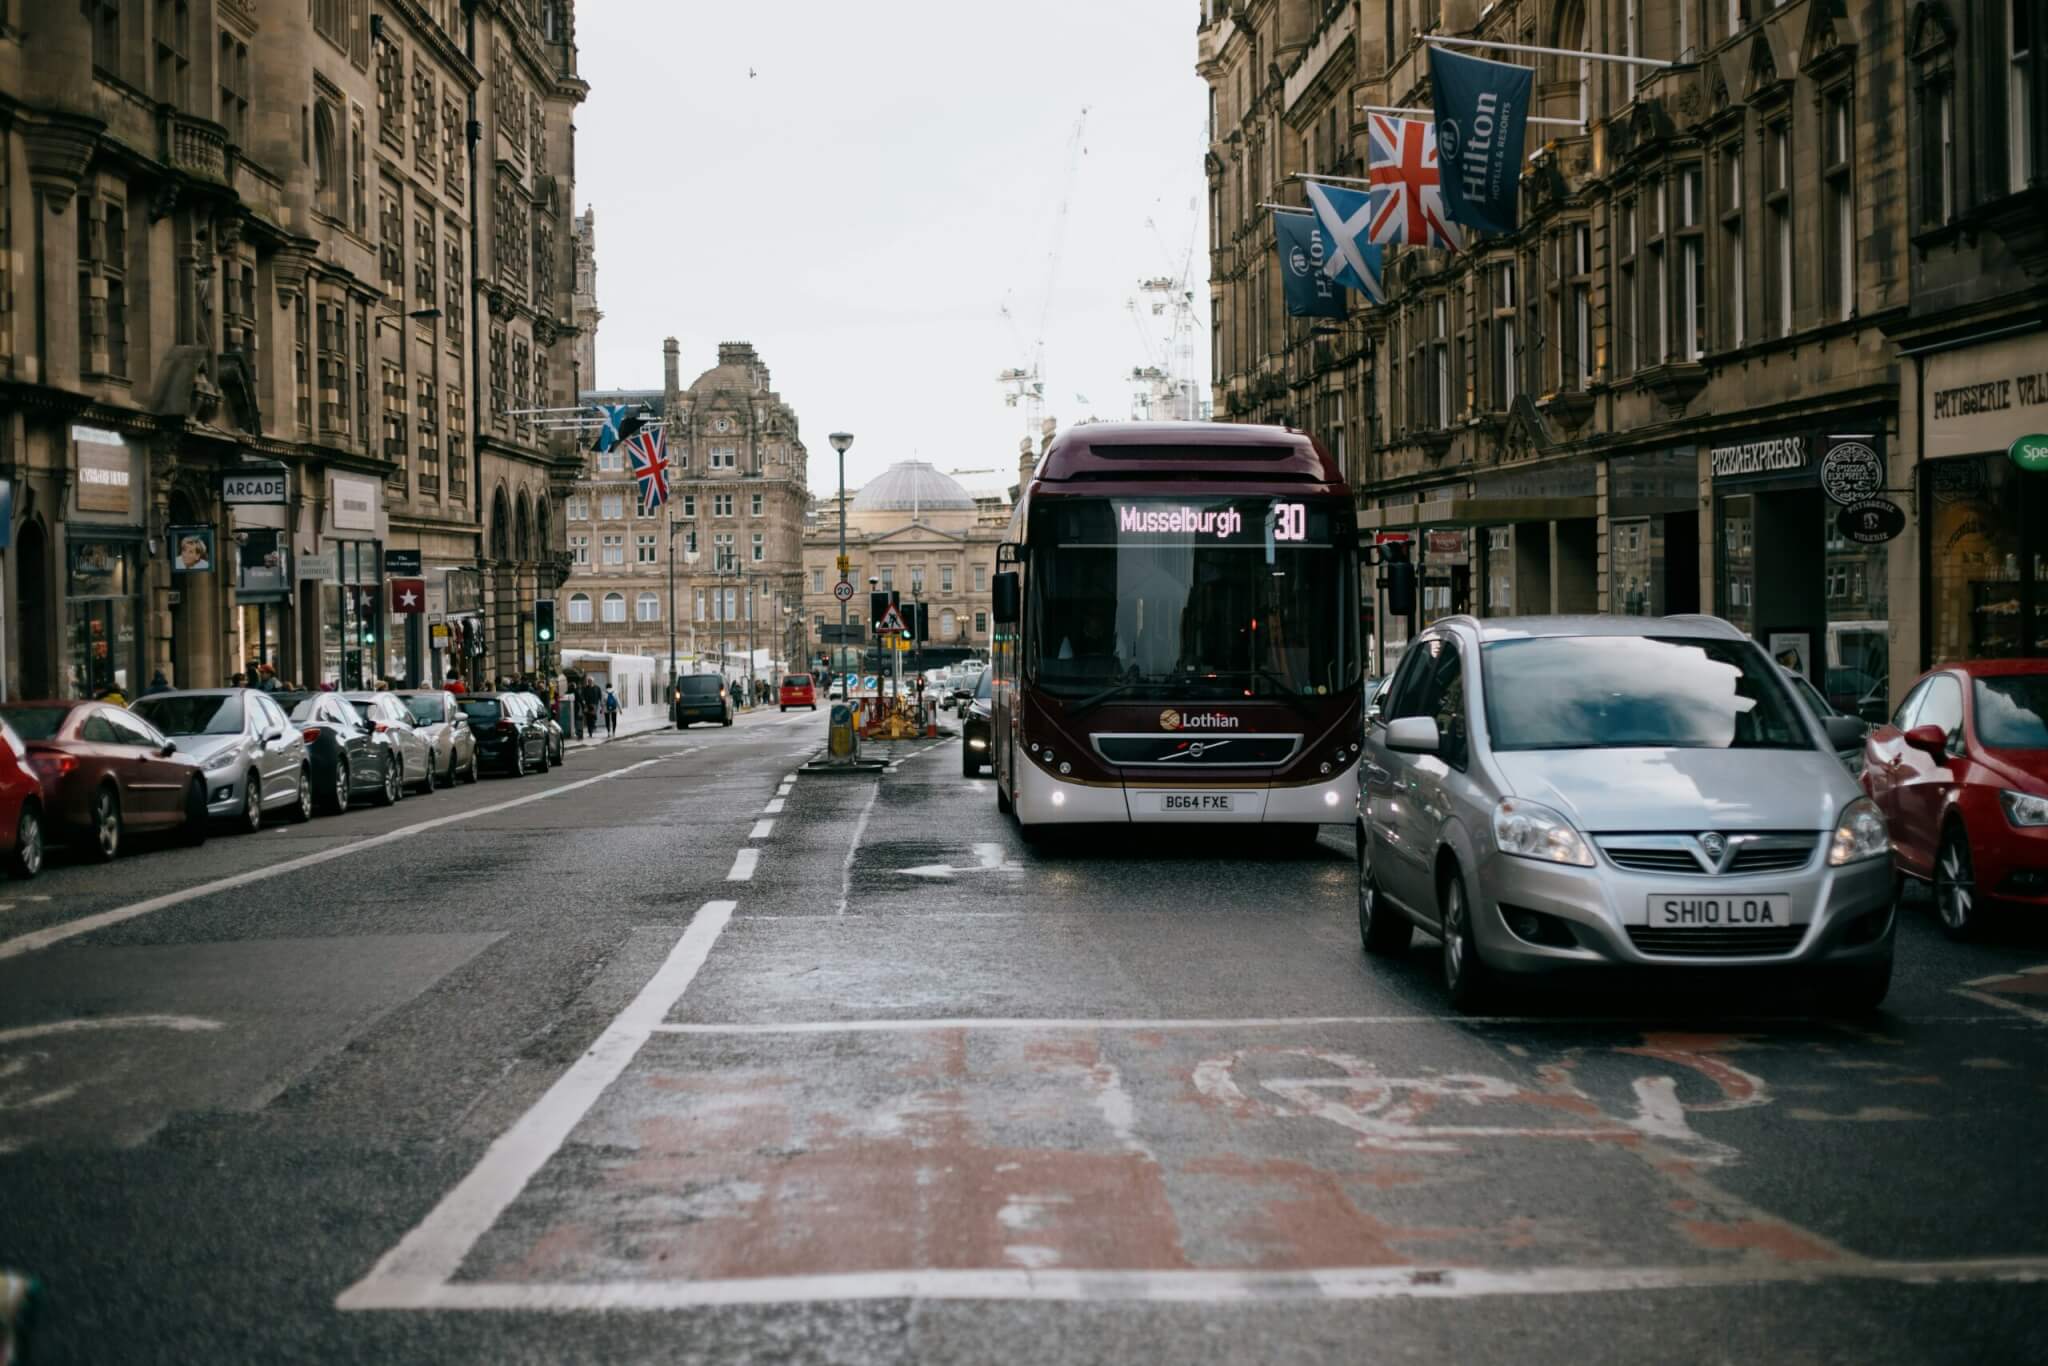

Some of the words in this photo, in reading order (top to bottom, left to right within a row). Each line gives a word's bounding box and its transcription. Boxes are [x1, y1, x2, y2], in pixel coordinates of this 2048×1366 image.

[1497, 101, 1512, 147] RESORTS
[1462, 92, 1498, 202] Hilton
[1496, 150, 1504, 158] &
[1492, 160, 1503, 200] HOTELS
[1933, 379, 2011, 420] PATISSERIE
[2016, 372, 2048, 407] VAL
[1836, 464, 1867, 472] PIZZA
[226, 482, 283, 496] ARCADE
[1120, 506, 1241, 538] Musselburgh
[1274, 503, 1305, 541] 30
[837, 586, 850, 596] 20
[1183, 713, 1239, 728] Lothian
[1166, 796, 1200, 808] BG64
[1203, 796, 1228, 808] FXE
[1664, 901, 1719, 923] SH10
[1727, 901, 1774, 923] LOA
